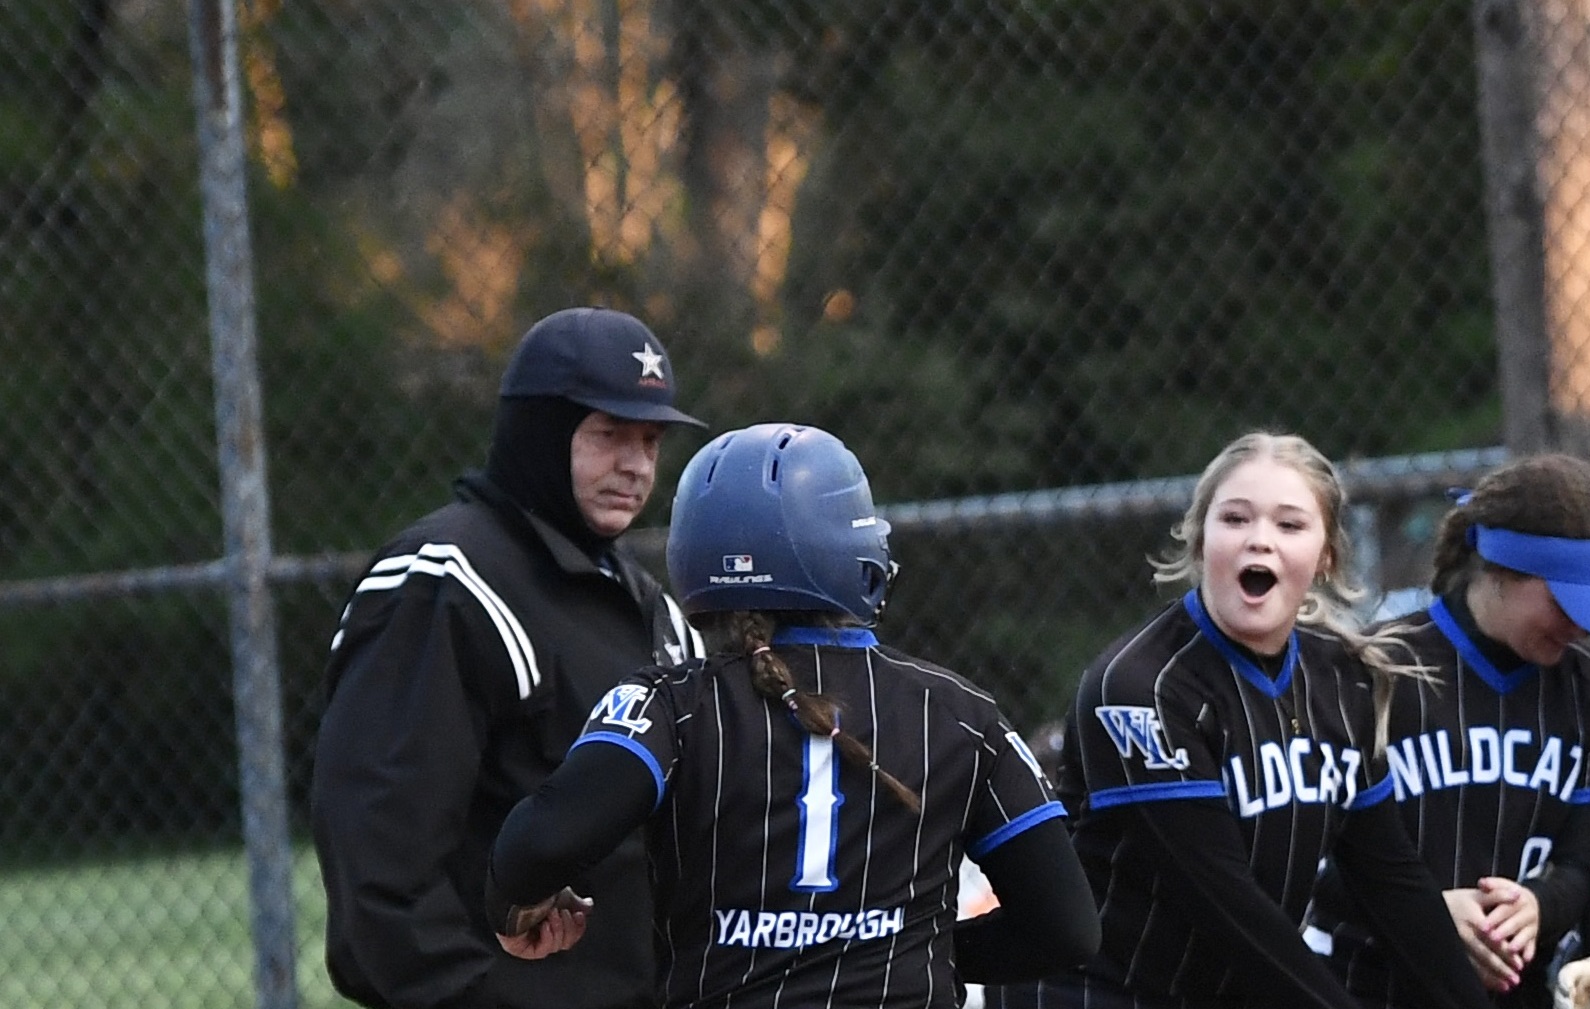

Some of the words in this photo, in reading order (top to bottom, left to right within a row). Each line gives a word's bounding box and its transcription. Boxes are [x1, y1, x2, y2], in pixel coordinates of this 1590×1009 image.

[1094, 705, 1190, 770] WL
[788, 708, 846, 893] 1
[714, 906, 906, 949] YARBROUGH
